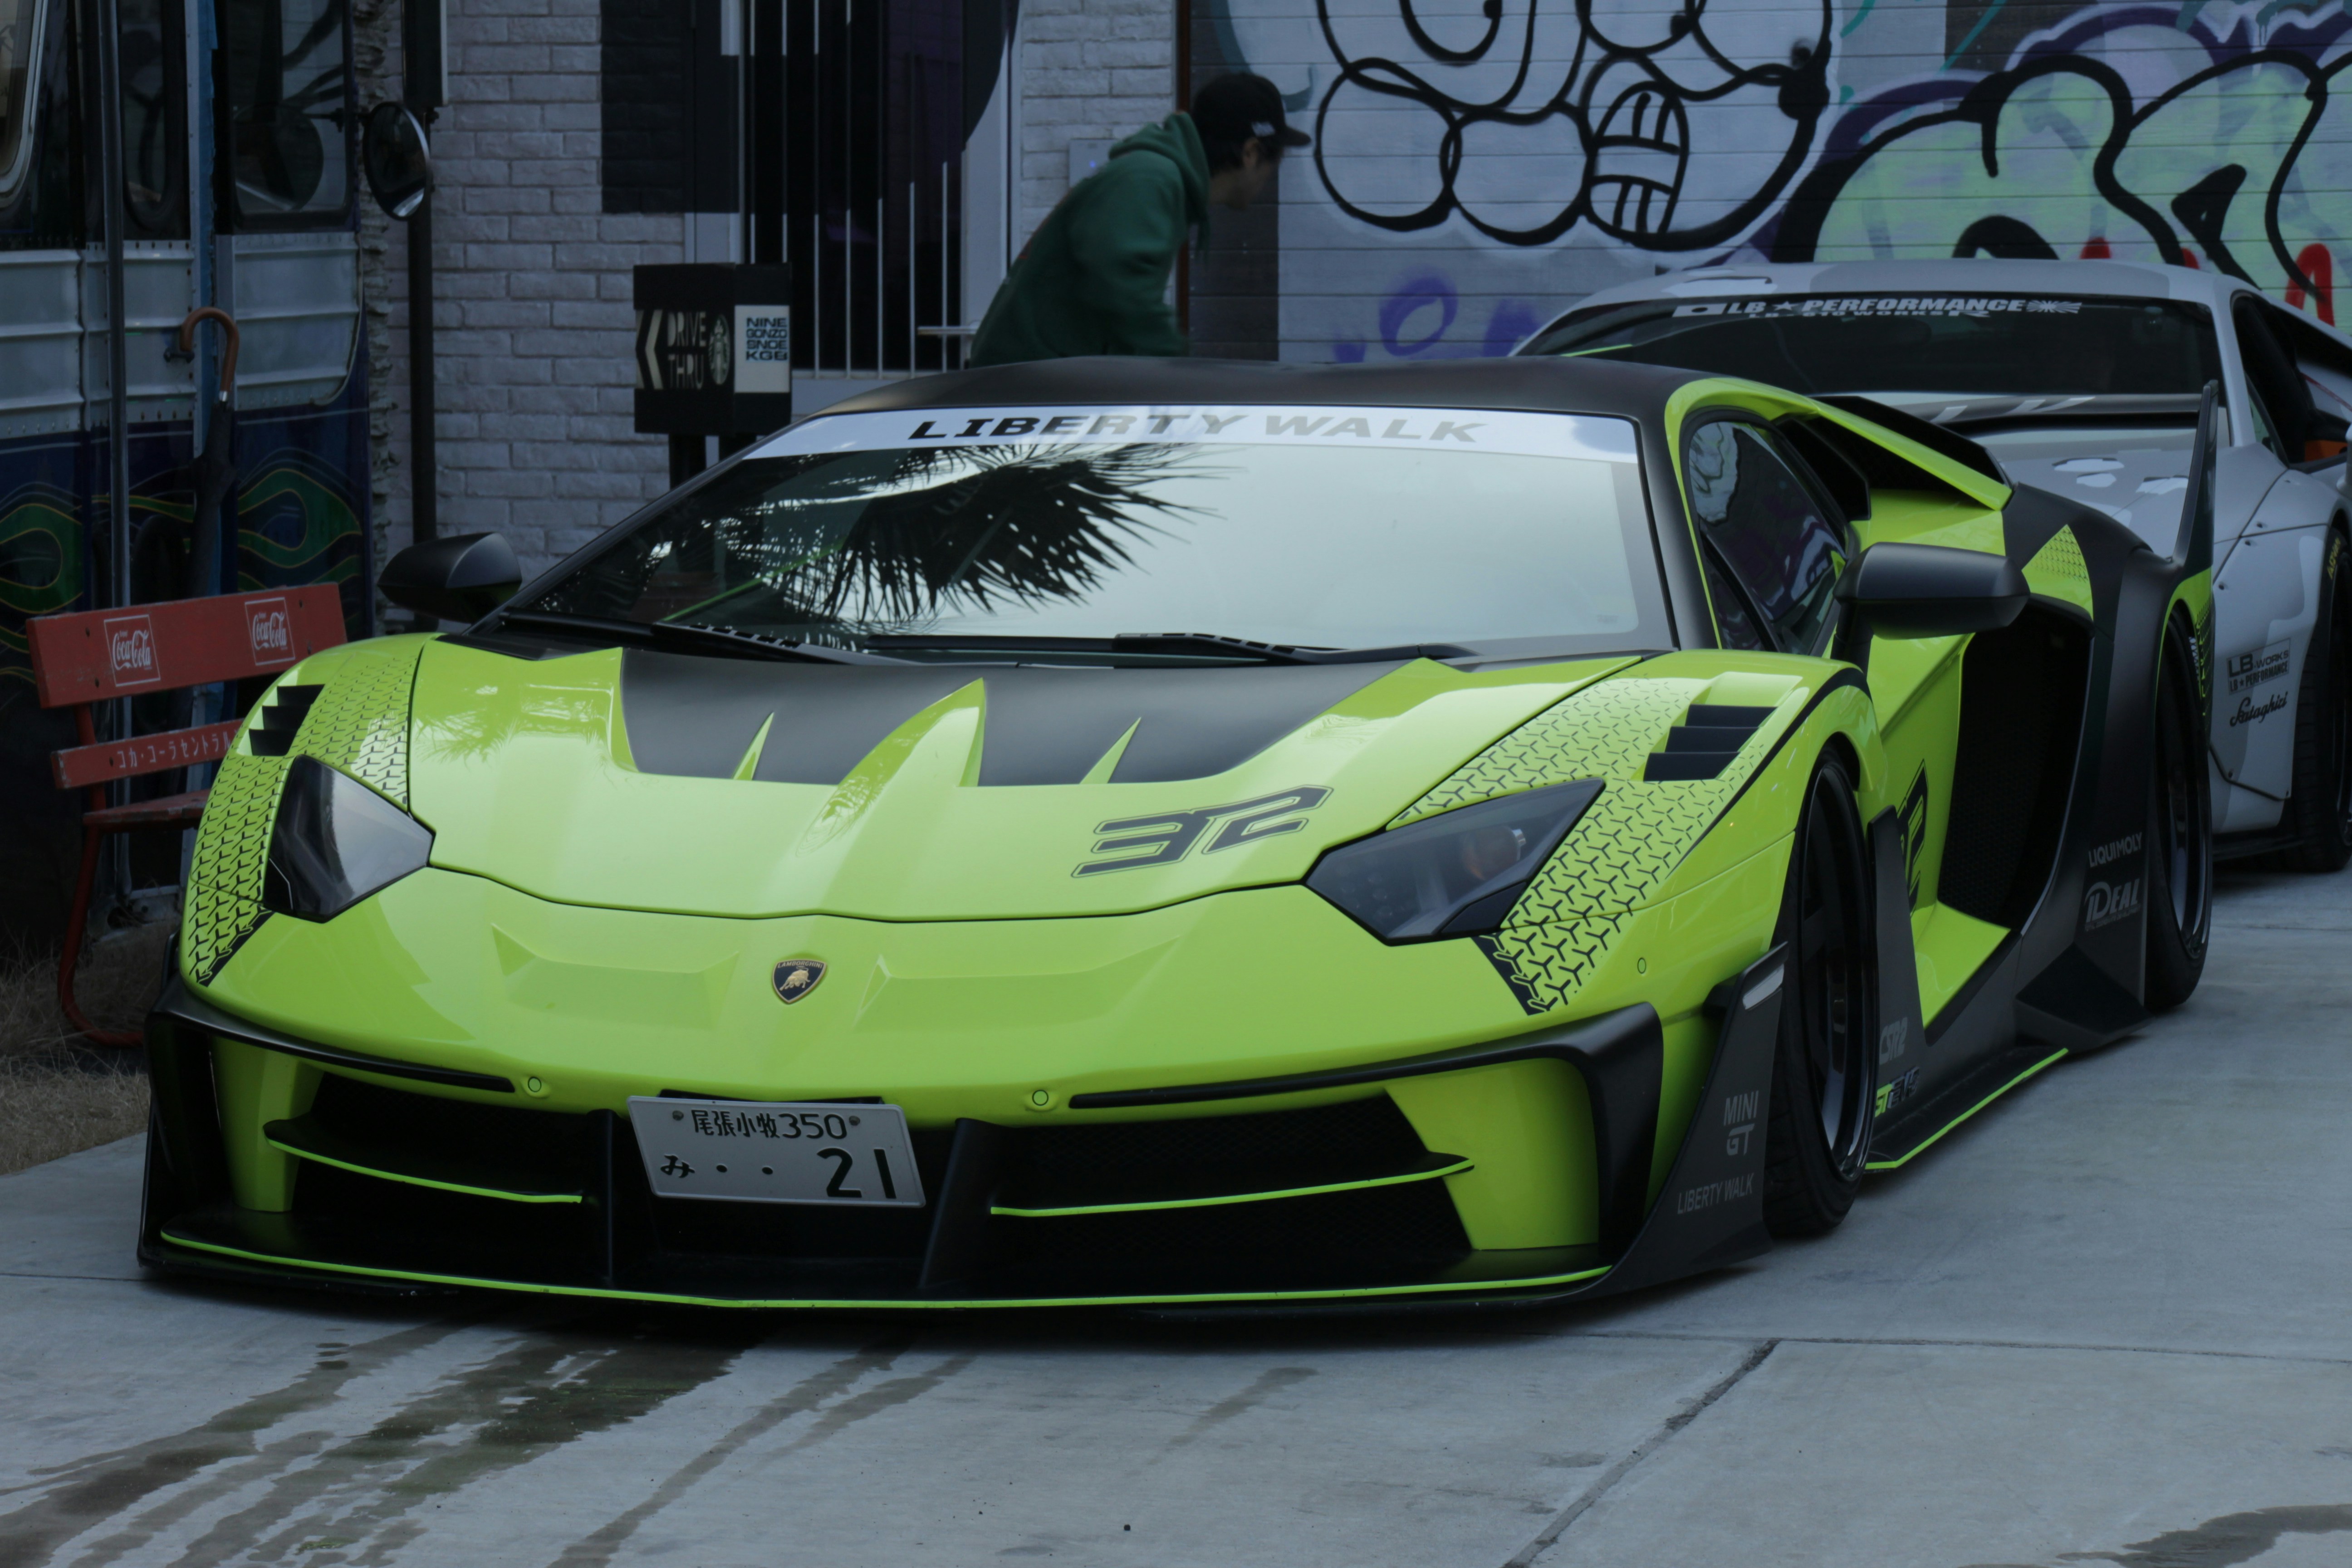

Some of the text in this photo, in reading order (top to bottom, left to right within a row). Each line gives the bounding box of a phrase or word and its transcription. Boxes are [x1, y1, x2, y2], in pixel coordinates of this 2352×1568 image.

[747, 318, 787, 327] NINE
[1727, 298, 2026, 314] LB PERFORMANCE
[667, 310, 706, 347] DRIVE
[747, 328, 787, 338] GONZO
[668, 353, 704, 390] THRU
[908, 414, 1489, 443] LIBERTY WALK
[2230, 661, 2288, 692] LB PERFORMANCE
[1072, 784, 1333, 877] 32
[777, 960, 823, 969] LAMBORGHINI
[1724, 1090, 1759, 1127] MINI
[1726, 1123, 1755, 1156] GT
[660, 1154, 695, 1178] み
[817, 1147, 897, 1199] 21
[1677, 1172, 1754, 1215] LIBERTY WALK
